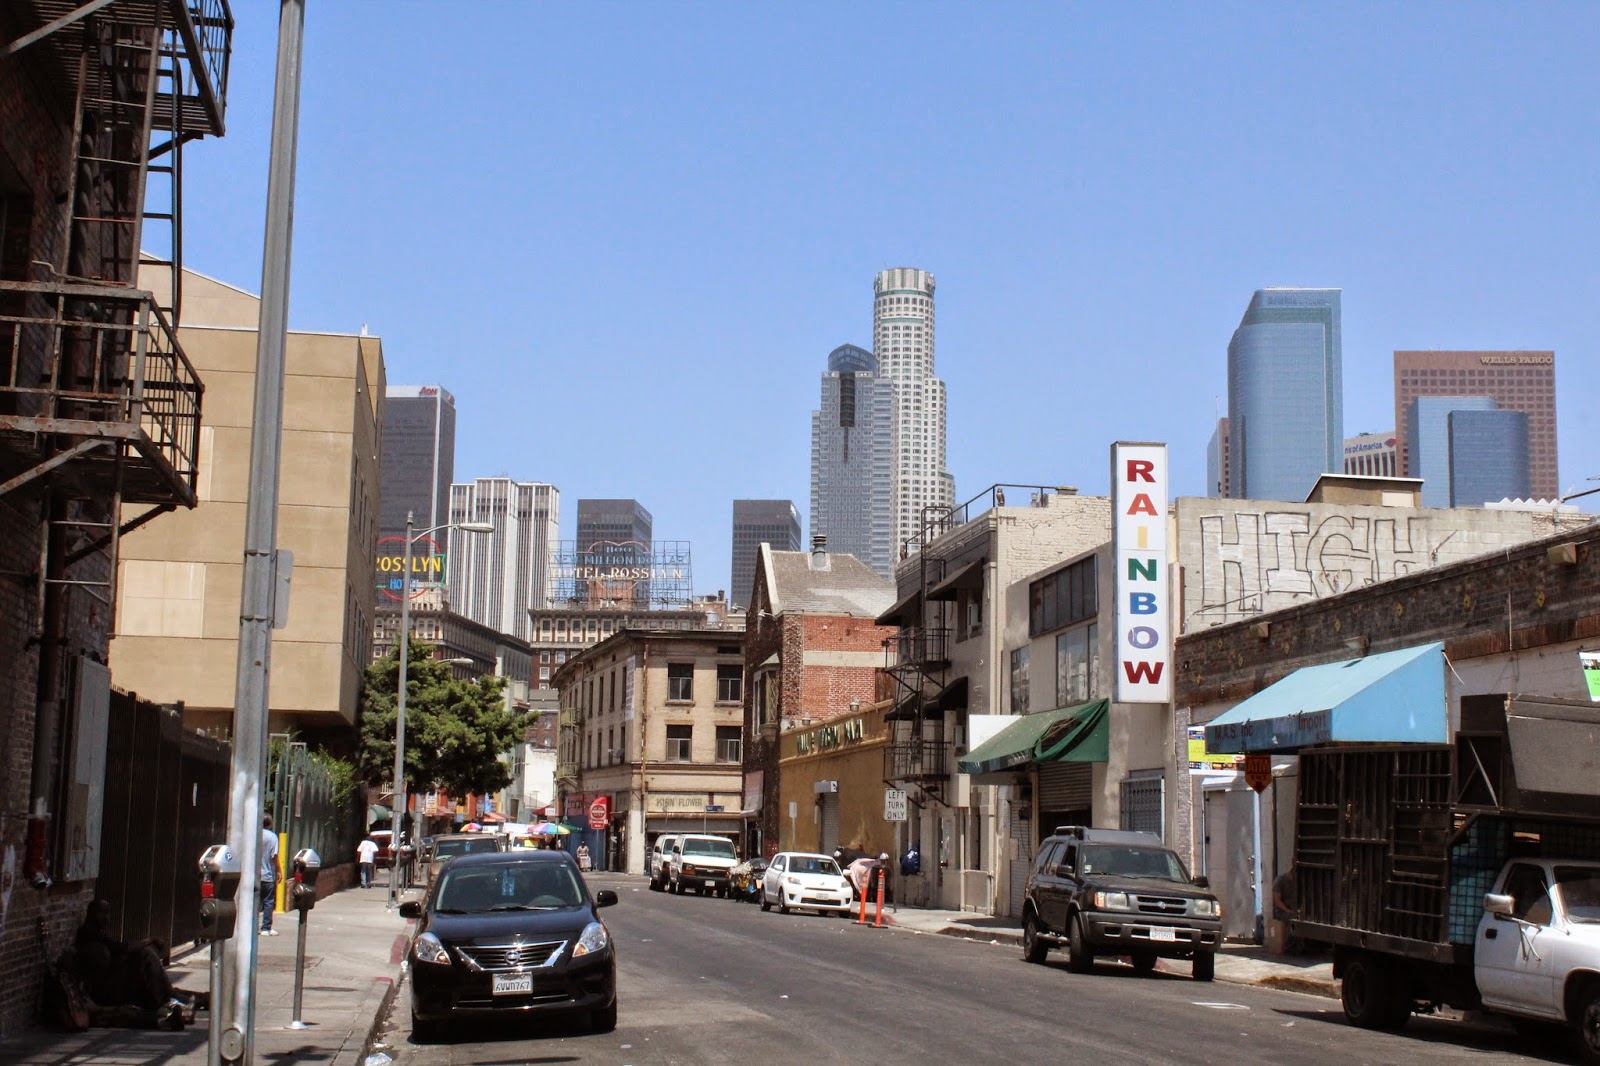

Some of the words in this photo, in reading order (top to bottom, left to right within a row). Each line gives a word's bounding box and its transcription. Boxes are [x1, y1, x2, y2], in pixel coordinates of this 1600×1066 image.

[1480, 356, 1516, 366] WELLS
[1518, 356, 1553, 366] FARGO
[584, 555, 634, 565] MILLION
[552, 567, 603, 579] HOTEL
[610, 567, 682, 579] ROSSLYN
[1123, 459, 1165, 685] RAINBOW
[888, 791, 905, 799] LEFT
[678, 798, 703, 808] FLOWER
[888, 801, 904, 809] TURN
[887, 811, 905, 819] ONLY
